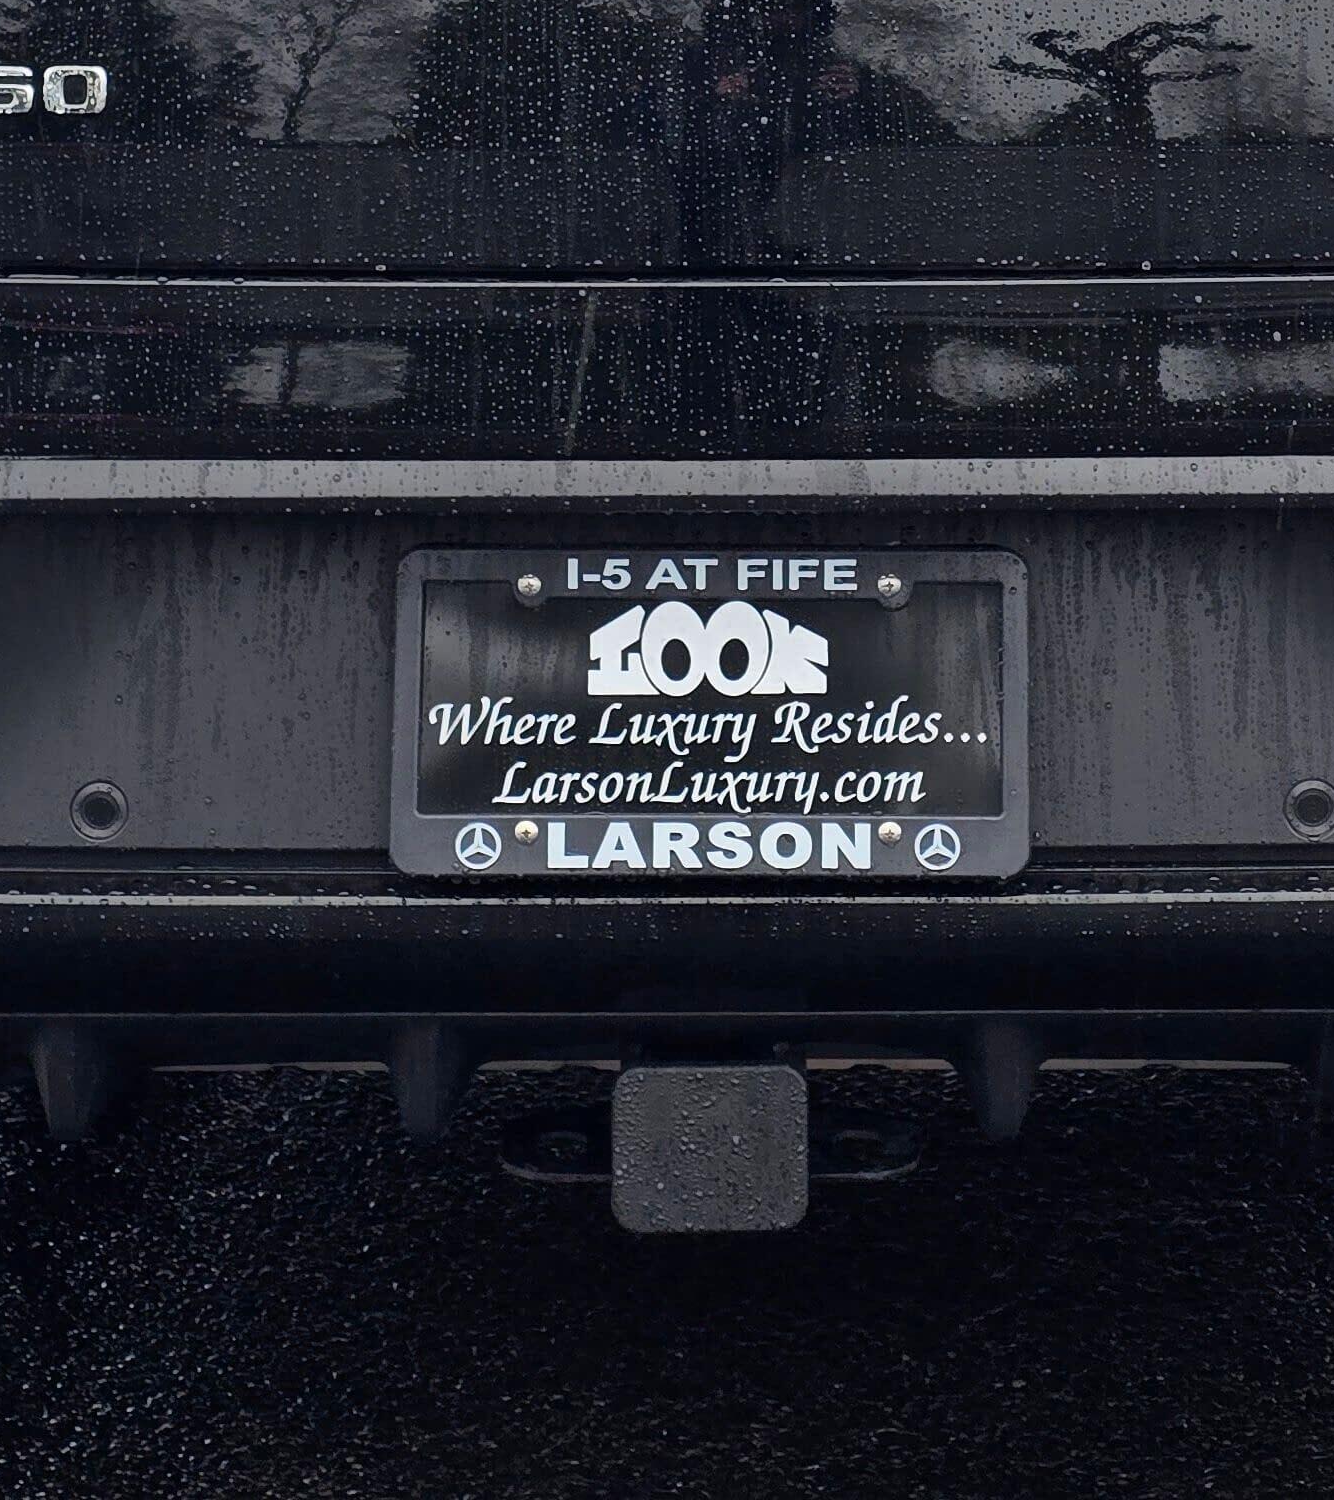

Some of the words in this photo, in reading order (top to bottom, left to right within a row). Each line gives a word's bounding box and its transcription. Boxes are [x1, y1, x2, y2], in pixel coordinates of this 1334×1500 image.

[568, 559, 631, 589] I-5
[646, 559, 718, 590] AT
[738, 559, 857, 590] FIFE
[429, 696, 576, 746] Where
[589, 702, 755, 761] Luxury
[772, 695, 988, 750] Resides...
[492, 762, 925, 813] LarsonLuxury.com
[547, 823, 871, 869] LARSON
